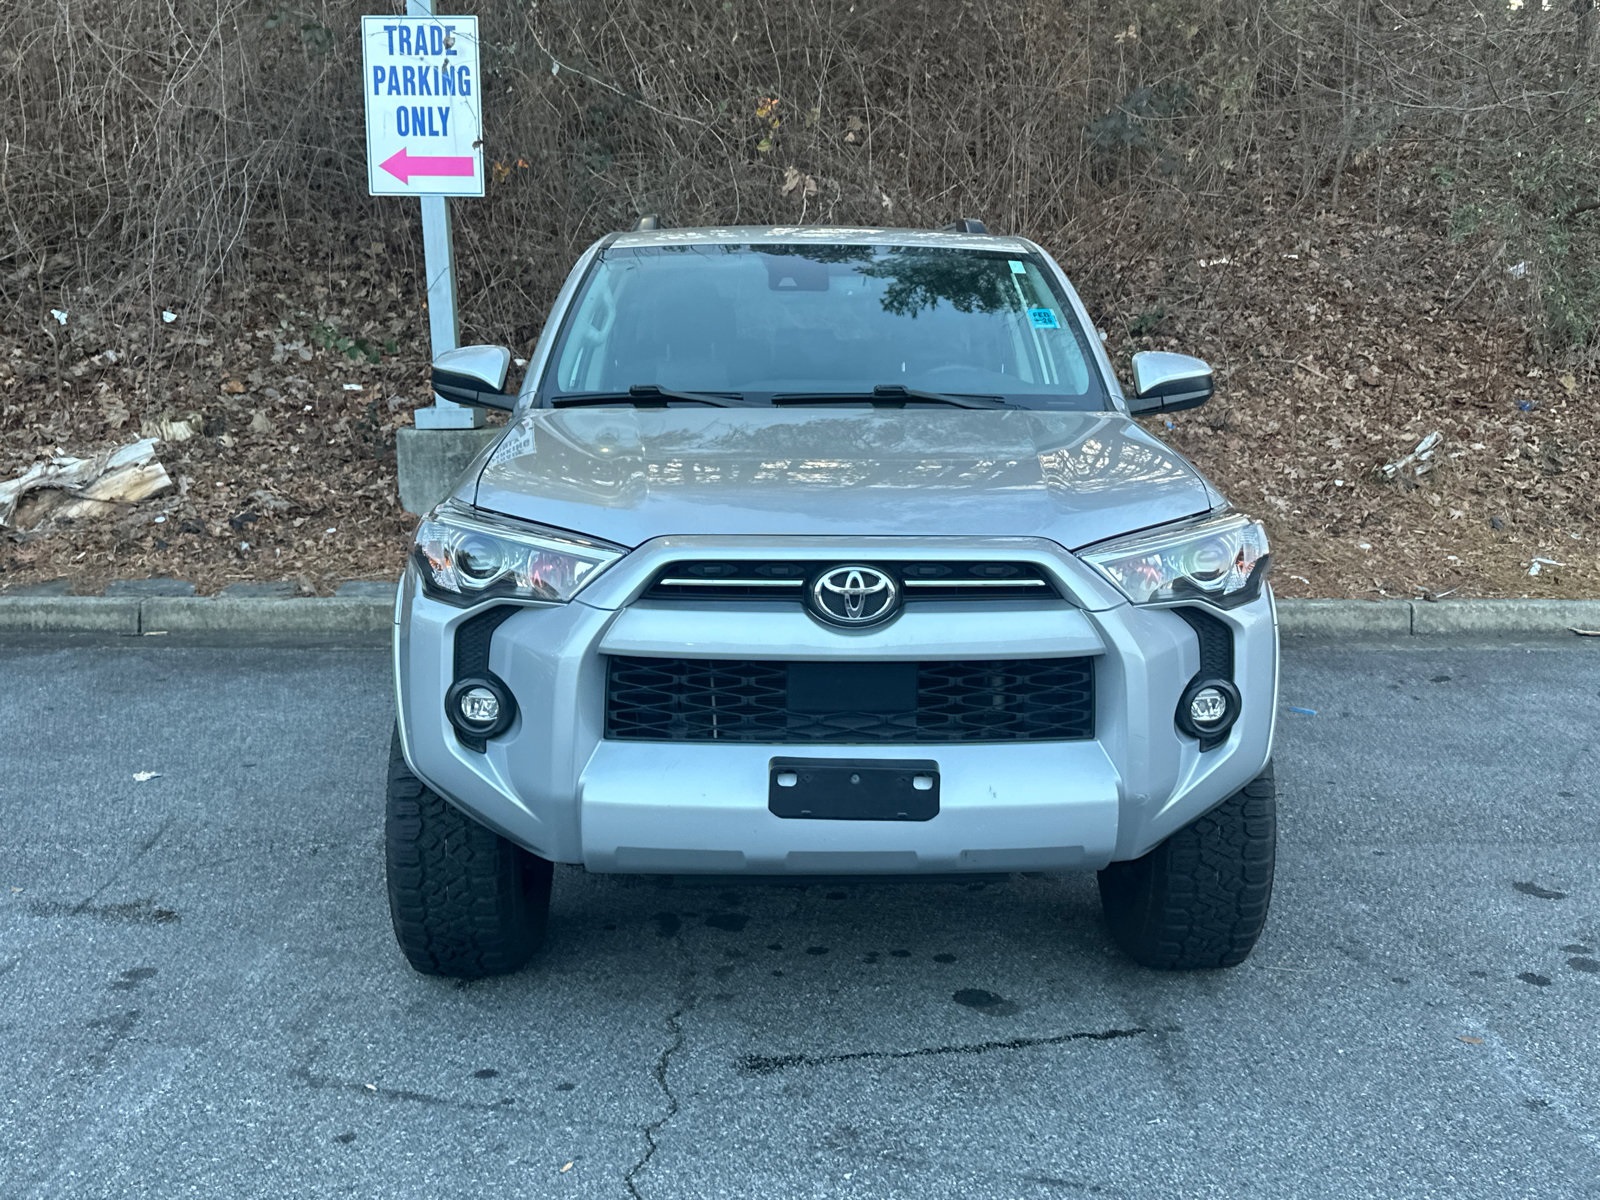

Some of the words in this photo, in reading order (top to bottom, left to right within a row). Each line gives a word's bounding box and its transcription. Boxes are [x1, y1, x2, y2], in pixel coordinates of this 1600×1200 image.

[383, 25, 457, 56] TRADE
[373, 65, 471, 96] PARKING
[396, 105, 450, 137] ONLY
